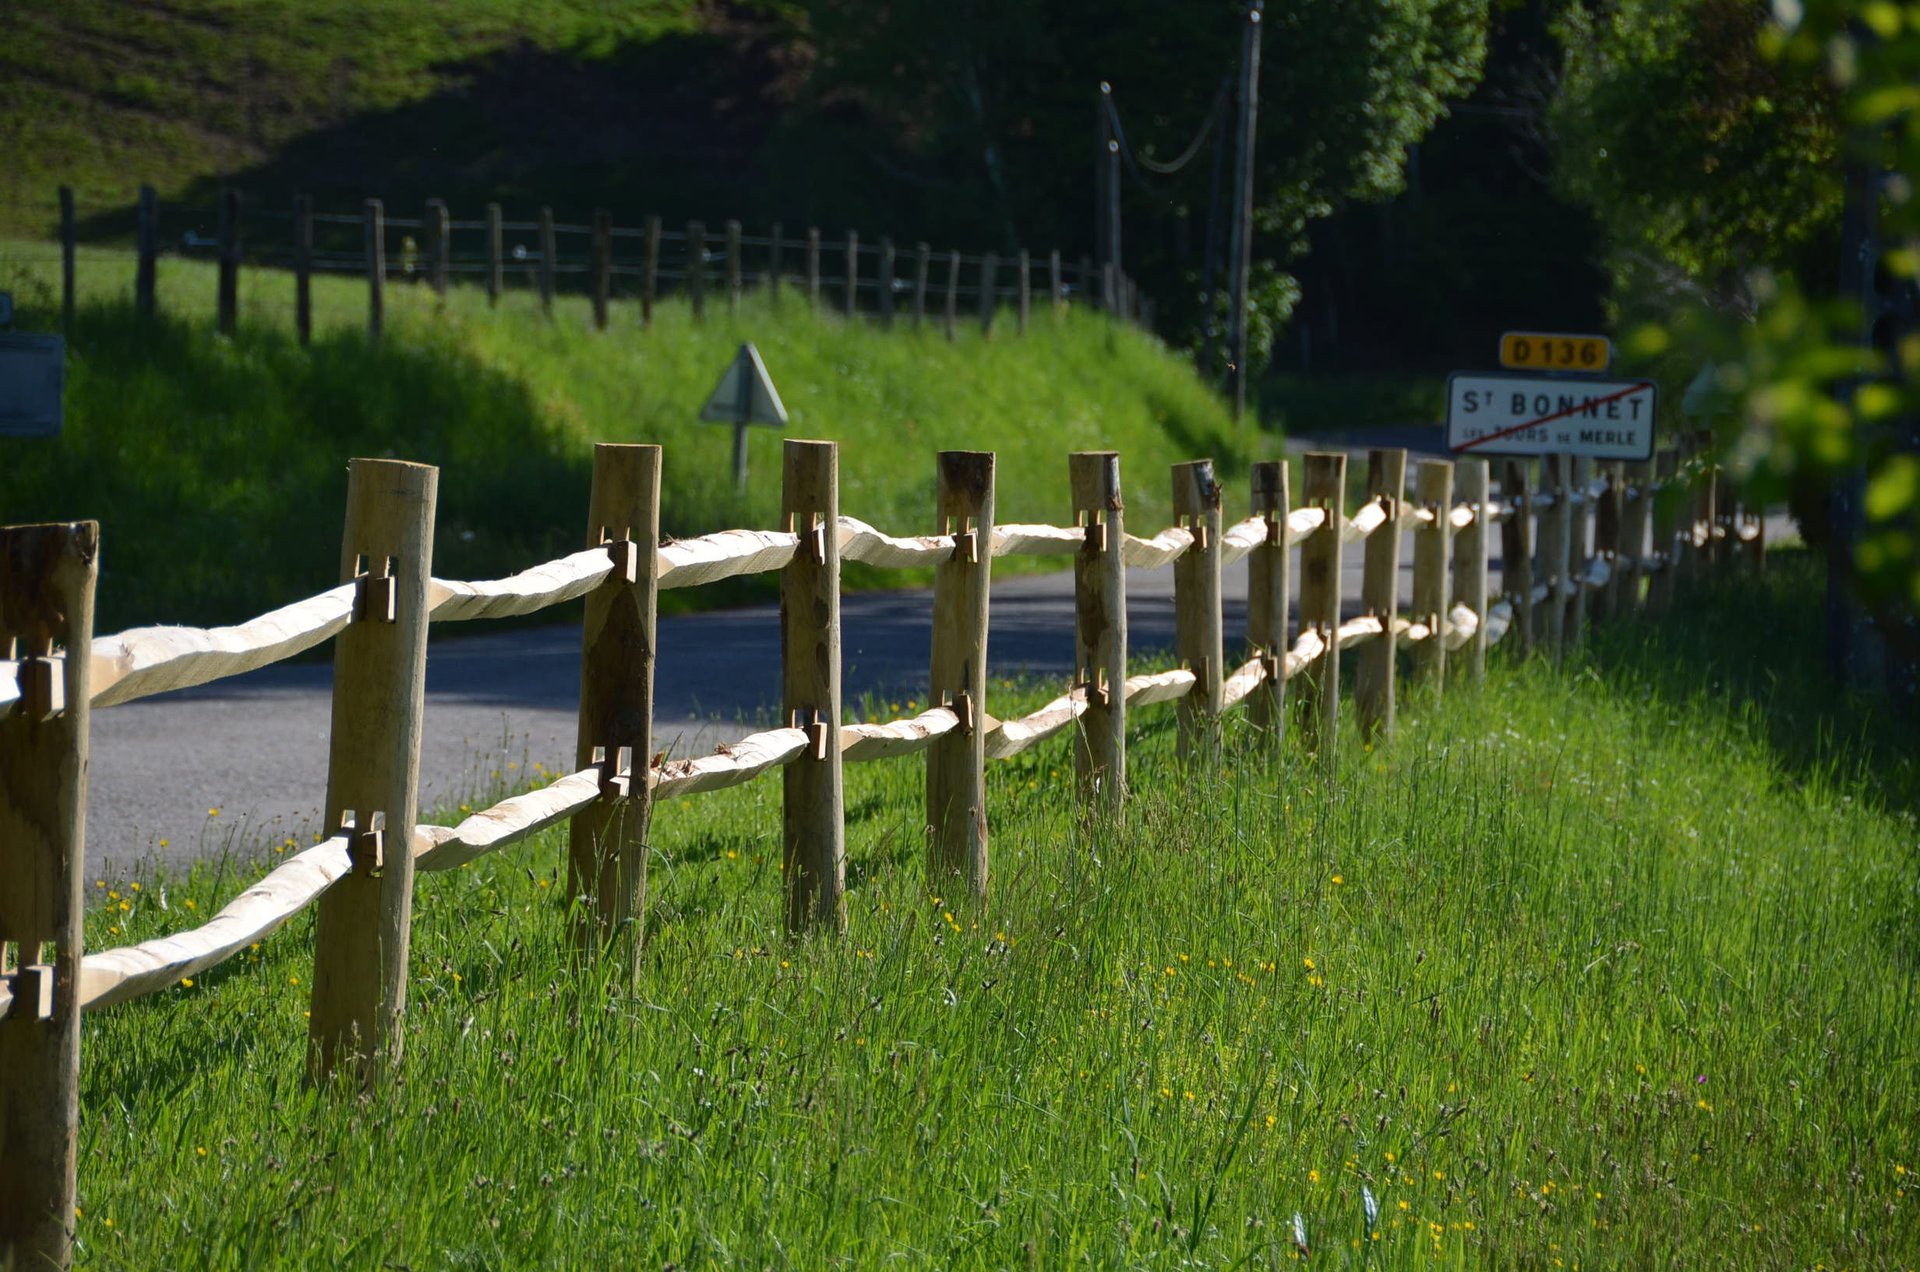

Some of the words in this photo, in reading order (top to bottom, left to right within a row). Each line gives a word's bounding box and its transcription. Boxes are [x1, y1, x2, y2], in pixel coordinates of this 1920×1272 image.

[1513, 339, 1530, 362] D
[1542, 341, 1597, 365] 136
[1511, 394, 1644, 419] BONNET
[1580, 430, 1636, 446] MERLE
